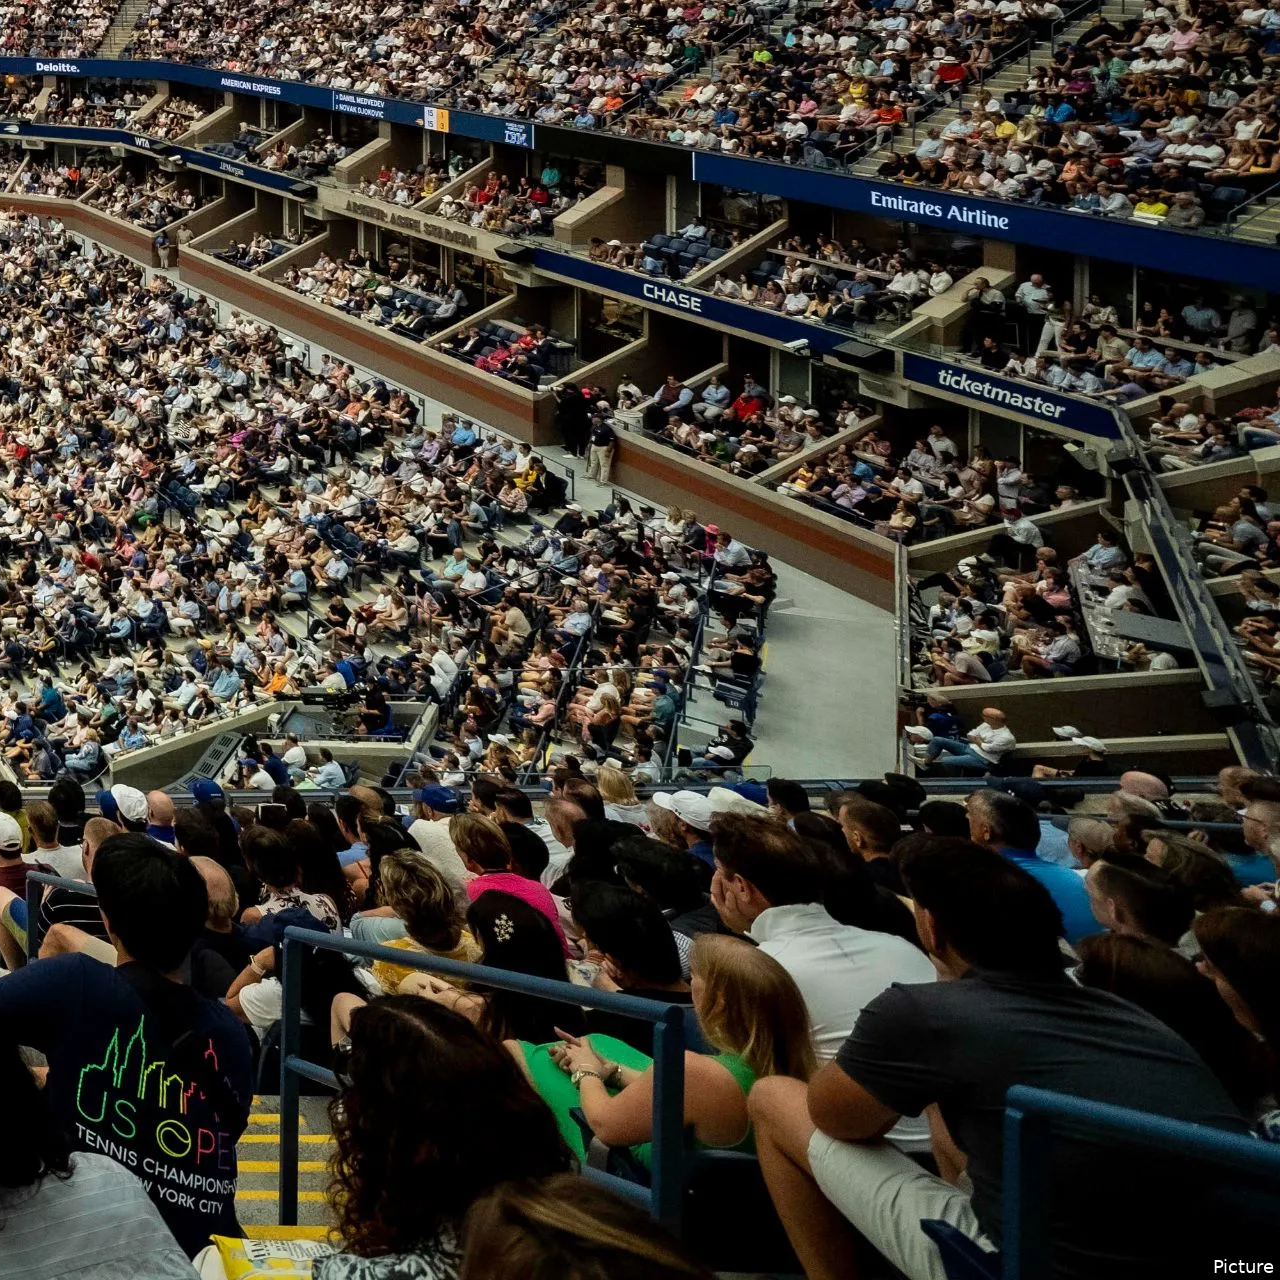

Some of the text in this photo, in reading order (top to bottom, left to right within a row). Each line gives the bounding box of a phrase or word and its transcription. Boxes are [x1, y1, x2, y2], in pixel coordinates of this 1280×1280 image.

[36, 62, 80, 73] Deloitte.
[221, 77, 281, 95] AMERICAN EXPRESS
[339, 103, 357, 113] NOVAK
[357, 106, 384, 118] DJOKOVIC
[356, 97, 385, 108] MEDVEDEV
[427, 109, 433, 117] 15
[427, 120, 433, 128] 15
[504, 131, 528, 146] IBM
[871, 191, 1009, 231] Emirates Airline
[643, 283, 702, 312] CHASE
[937, 370, 1066, 420] ticketmaster
[76, 1122, 138, 1167] TENNIS
[156, 1118, 238, 1171] OPE
[158, 1184, 196, 1210] YORK
[199, 1199, 224, 1215] CITY
